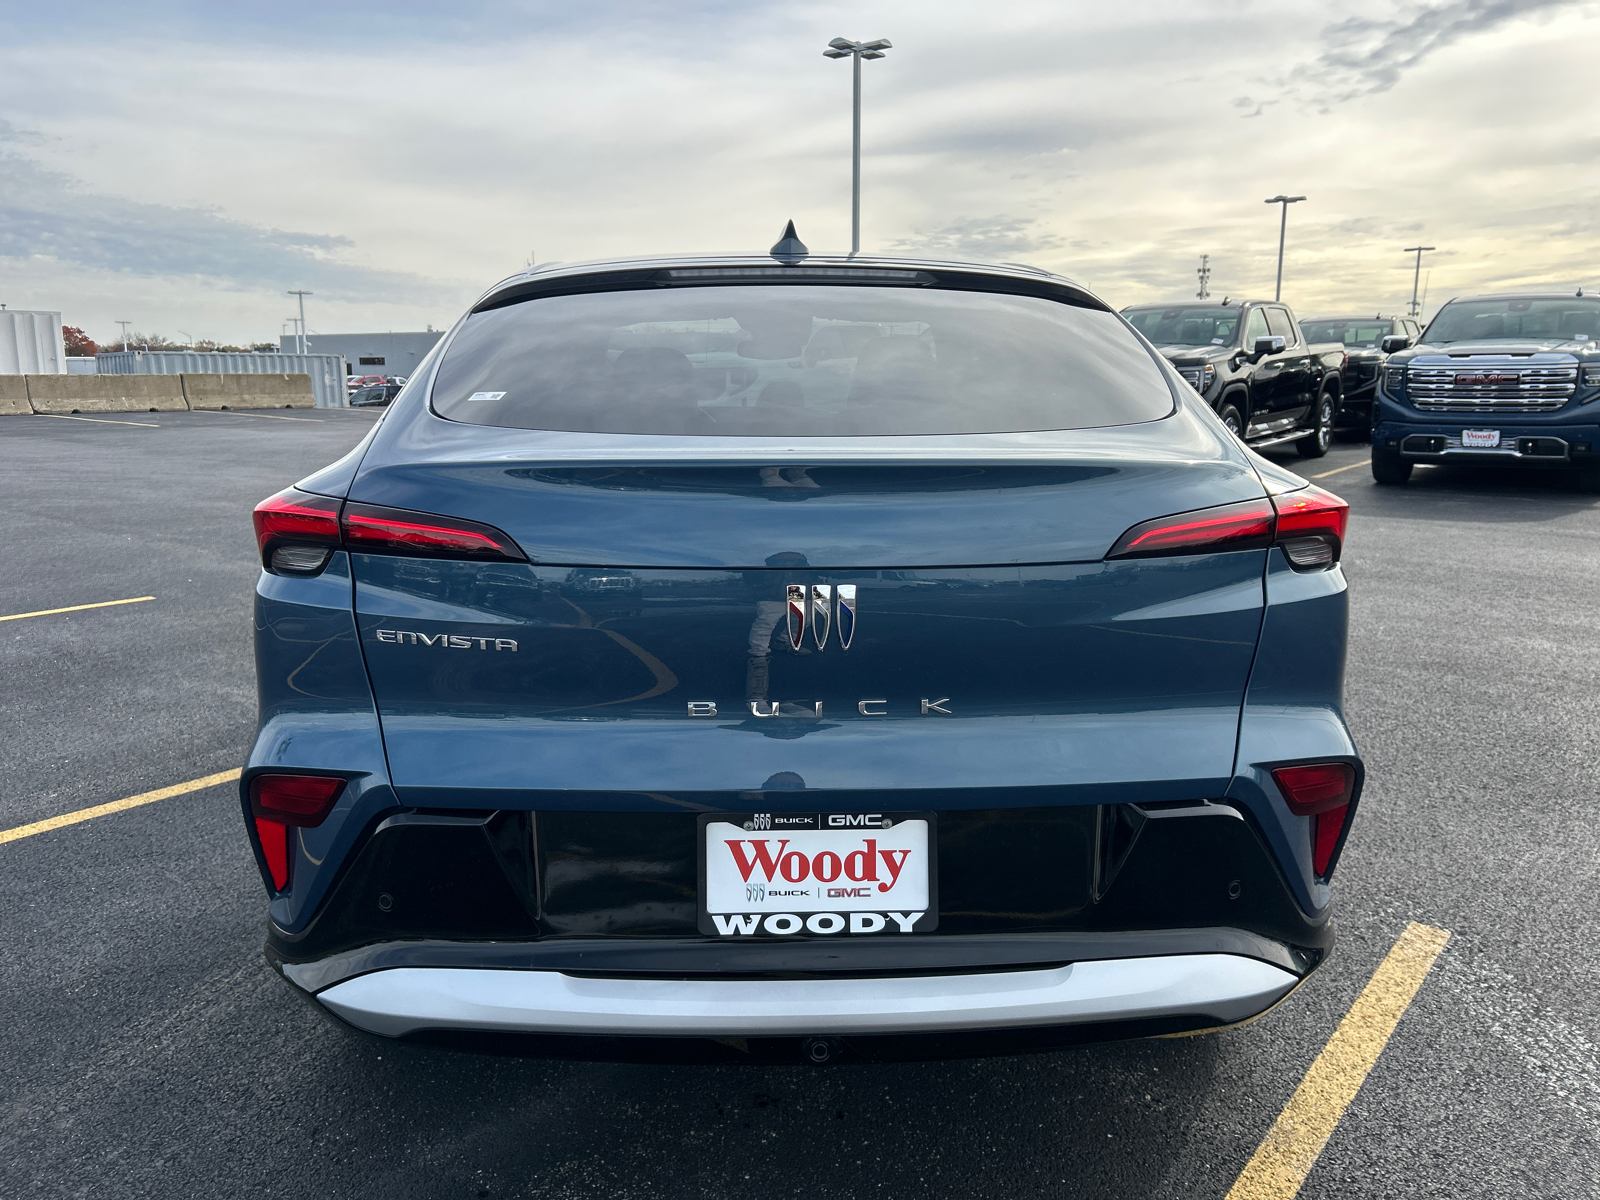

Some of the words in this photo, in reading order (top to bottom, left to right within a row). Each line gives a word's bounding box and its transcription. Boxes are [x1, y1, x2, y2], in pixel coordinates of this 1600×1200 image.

[1457, 374, 1518, 385] GMC
[1466, 432, 1496, 441] Woody
[376, 629, 518, 652] ENVISTA
[687, 698, 952, 717] BUICK
[828, 814, 882, 826] GMC
[724, 839, 912, 893] Woody
[827, 887, 871, 898] GMC
[711, 912, 925, 935] WOODY
